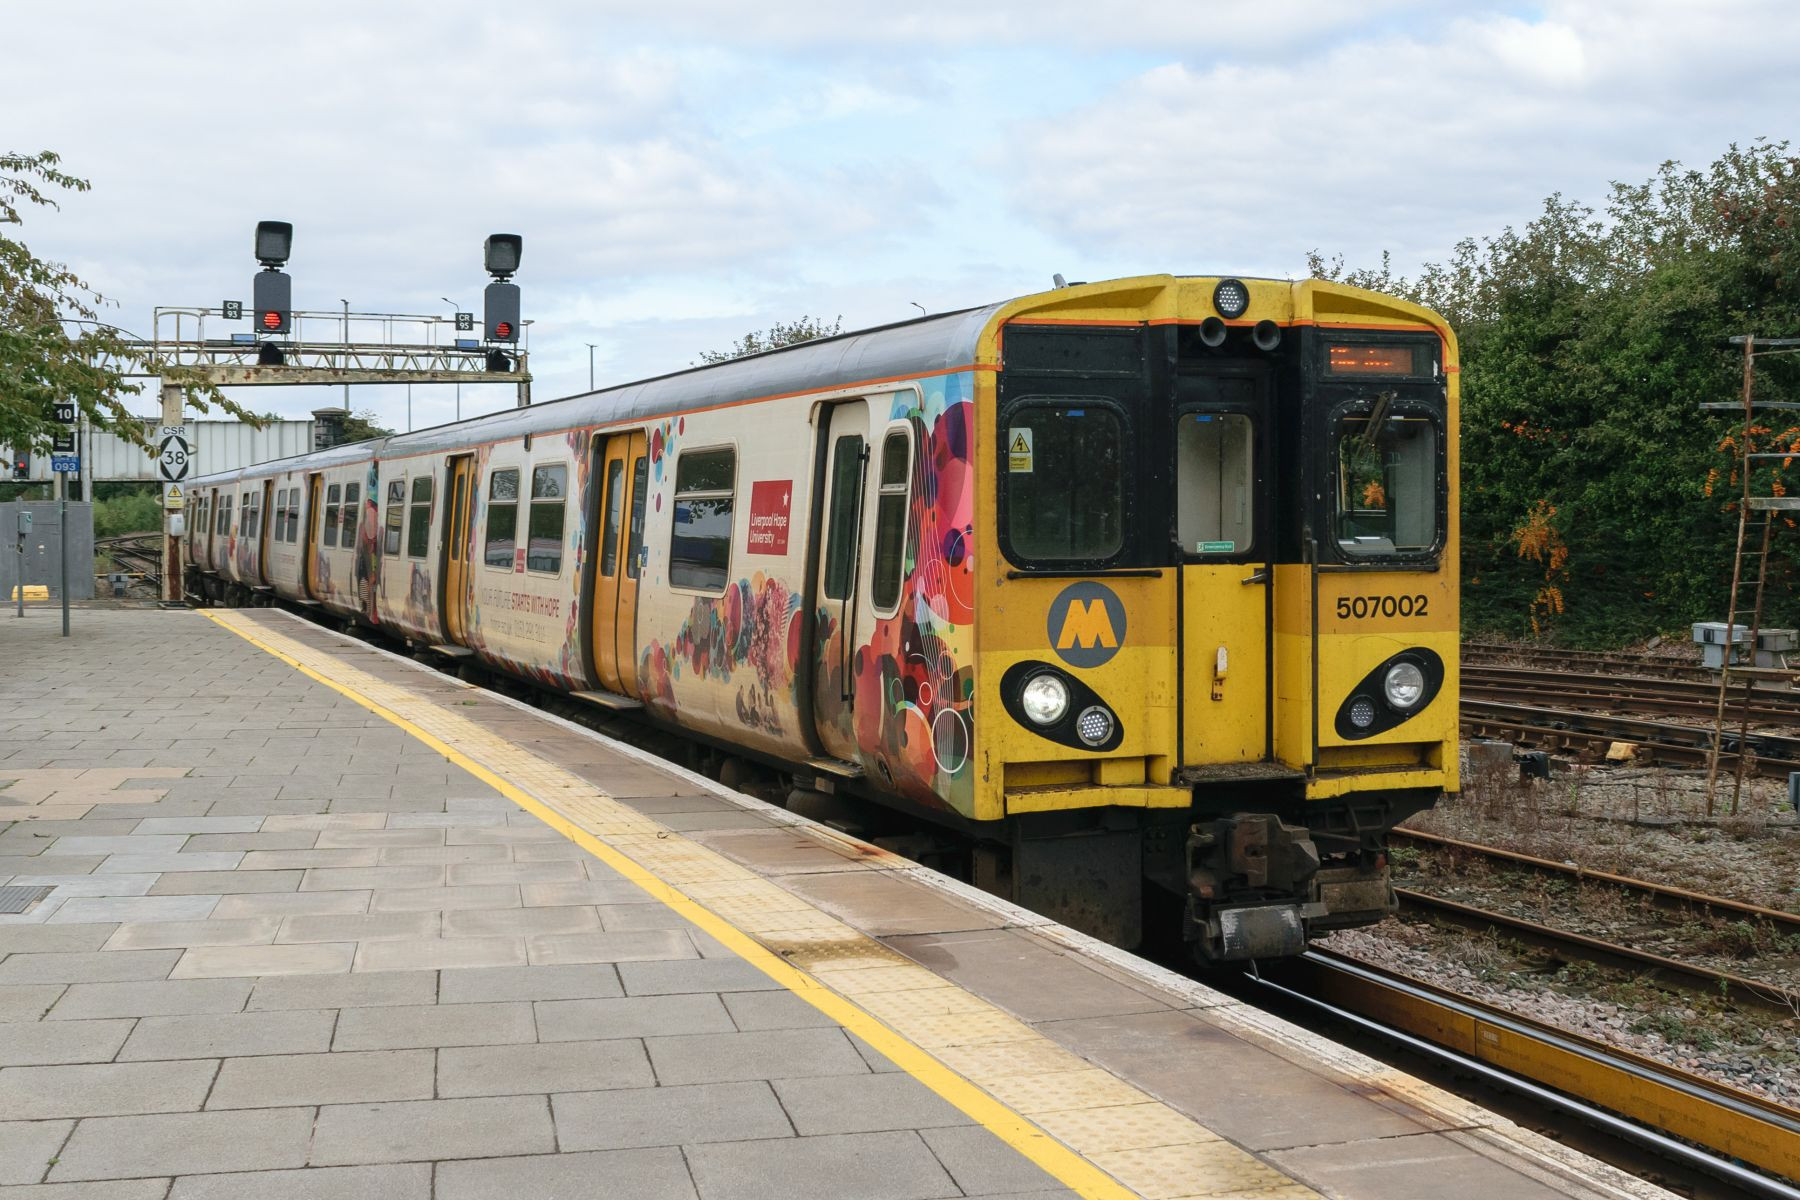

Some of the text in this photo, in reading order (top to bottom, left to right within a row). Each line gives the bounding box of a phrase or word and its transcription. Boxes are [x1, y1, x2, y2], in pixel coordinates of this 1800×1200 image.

[226, 302, 239, 310] CR
[227, 310, 238, 318] 93
[460, 322, 469, 330] 95
[57, 408, 72, 419] 10
[163, 426, 186, 435] CSR
[164, 450, 185, 465] 38
[54, 462, 76, 471] 093
[751, 512, 787, 530] Liverpool Hope
[750, 529, 775, 548] University
[511, 591, 530, 613] STARTS
[531, 595, 545, 616] WITH
[545, 597, 560, 618] HOPE
[1336, 594, 1429, 620] 507002
[1056, 598, 1119, 650] M
